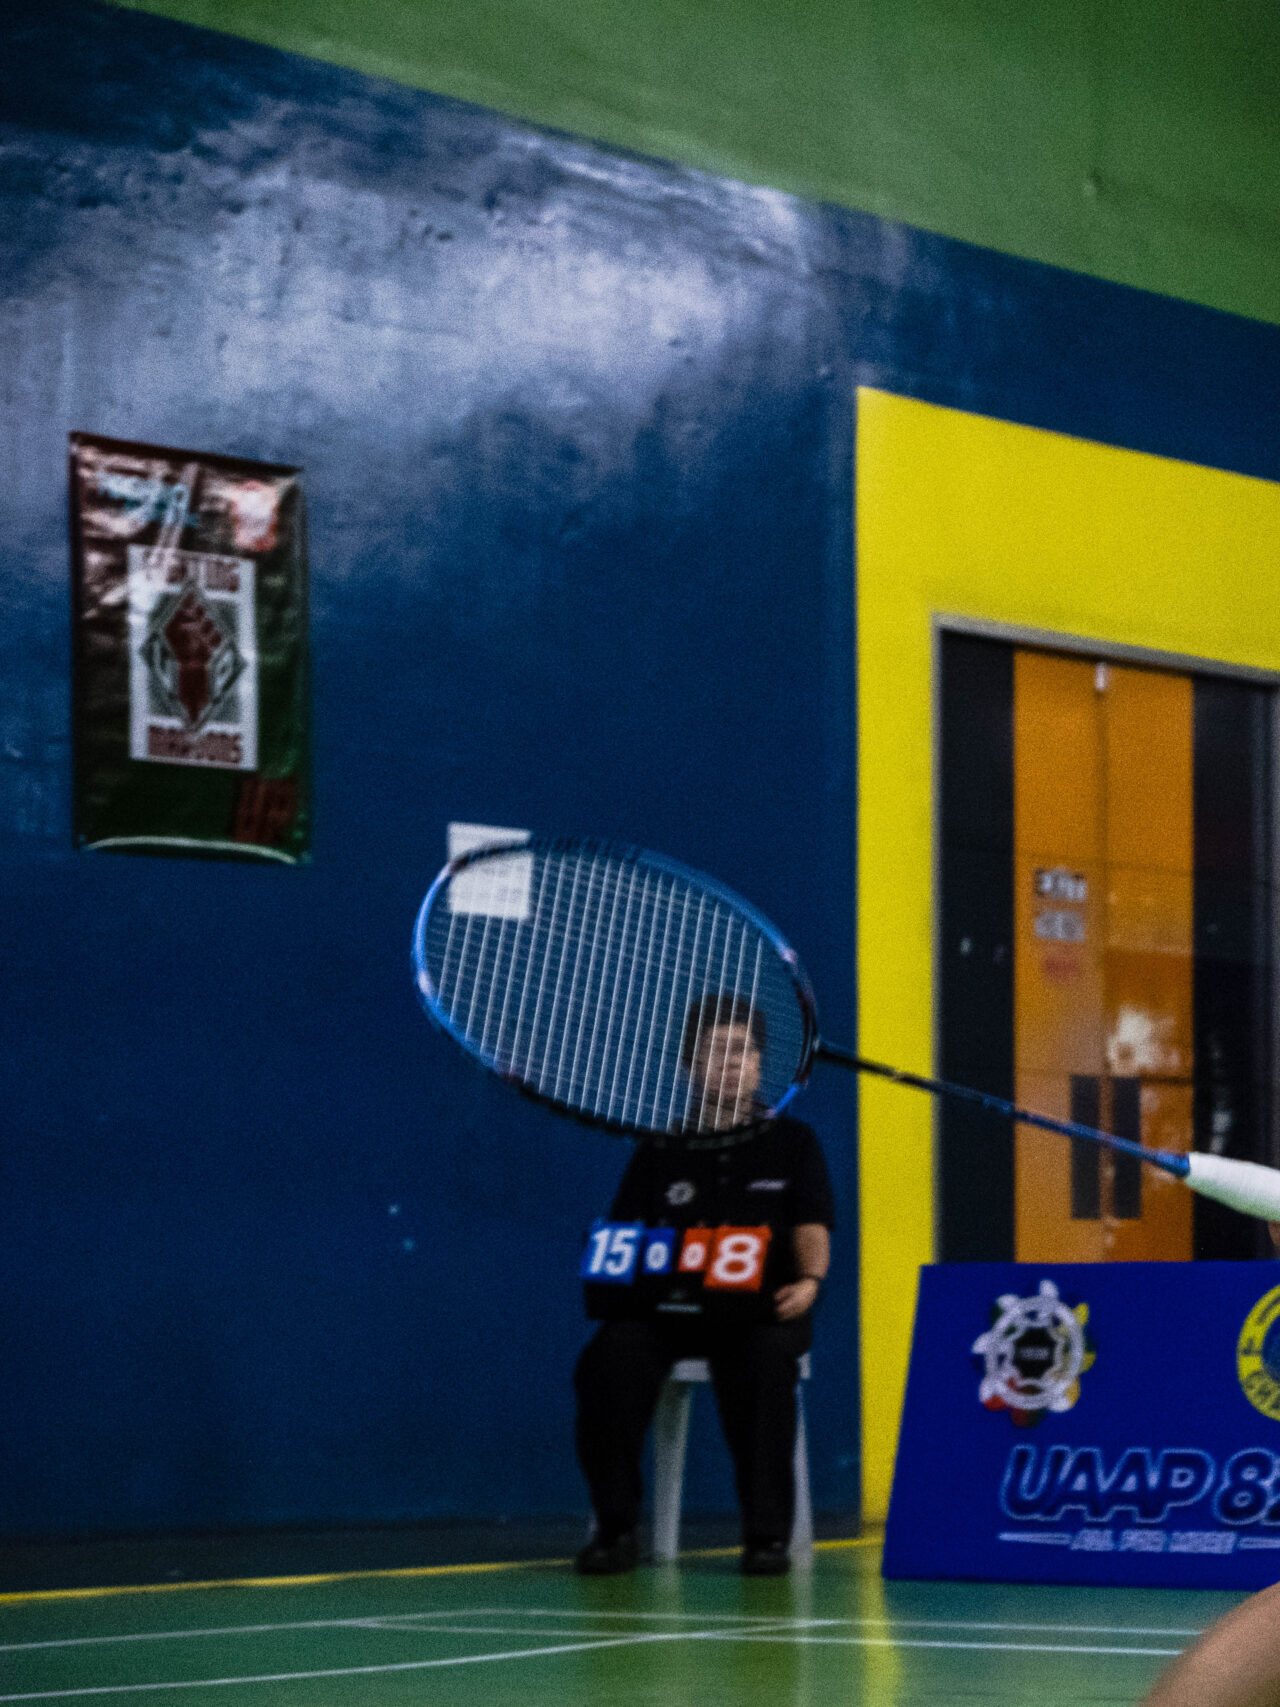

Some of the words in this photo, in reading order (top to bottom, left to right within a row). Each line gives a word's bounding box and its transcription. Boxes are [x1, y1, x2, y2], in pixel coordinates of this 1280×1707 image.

[589, 1227, 638, 1276] 15
[646, 1241, 669, 1271] 0
[682, 1241, 706, 1269] 0
[712, 1233, 762, 1283] 8
[1001, 1444, 1216, 1523] UAAP
